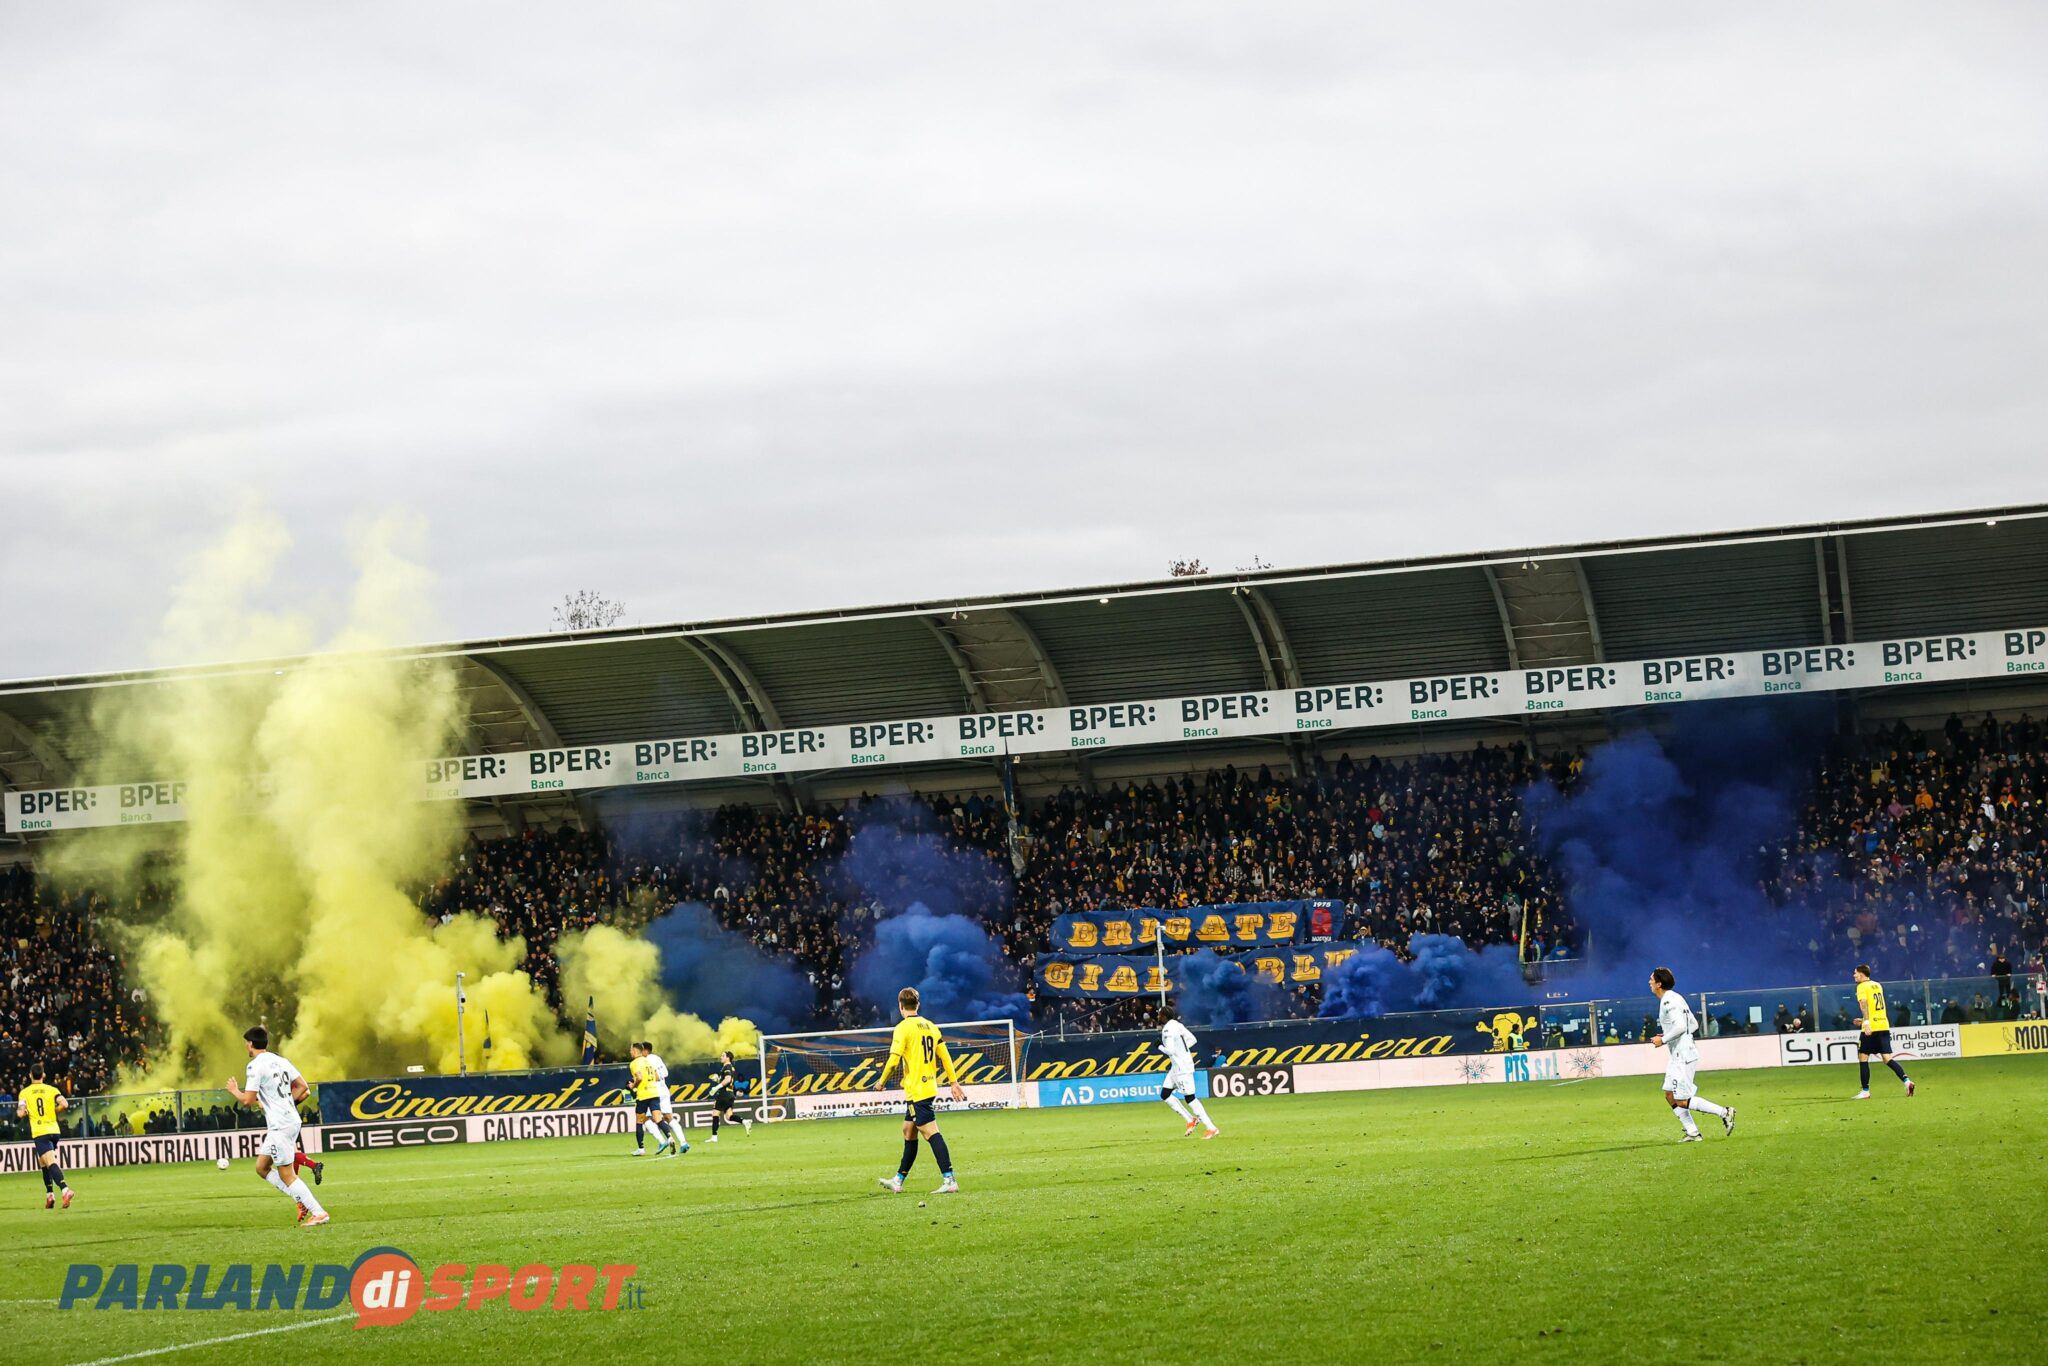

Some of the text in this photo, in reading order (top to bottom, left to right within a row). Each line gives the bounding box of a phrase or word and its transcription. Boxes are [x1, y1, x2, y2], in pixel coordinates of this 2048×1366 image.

[1762, 647, 1854, 676] BPER:
[1882, 637, 1976, 666] BPER:
[1643, 657, 1735, 685] BPER:
[1884, 670, 1922, 682] Banca
[2006, 660, 2045, 672] Banca
[1409, 676, 1499, 704] BPER:
[1526, 667, 1616, 694] BPER:
[1764, 680, 1801, 692] Banca
[1295, 685, 1383, 713] BPER:
[1527, 698, 1564, 710] Banca
[1645, 689, 1682, 701] Banca
[1070, 704, 1155, 731] BPER:
[1181, 695, 1268, 722] BPER:
[1411, 707, 1448, 720] Banca
[959, 713, 1044, 740] BPER:
[1183, 726, 1218, 738] Banca
[1296, 717, 1332, 729] Banca
[741, 730, 825, 757] BPER:
[850, 722, 934, 749] BPER:
[1071, 734, 1106, 746] Banca
[635, 739, 717, 766] BPER:
[851, 752, 885, 764] Banca
[960, 743, 994, 755] Banca
[425, 757, 506, 784] BPER:
[530, 748, 611, 775] BPER:
[743, 760, 777, 772] Banca
[531, 778, 564, 790] Banca
[636, 770, 670, 781] Banca
[20, 790, 96, 814] BPER:
[120, 782, 187, 808] BPER
[21, 819, 52, 830] Banca
[1068, 912, 1298, 947] BRIGATE
[1226, 1034, 1455, 1067] maniera
[1902, 1040, 1955, 1050] di guida
[1504, 1054, 1530, 1082] PTS
[1061, 1086, 1094, 1105] AD
[1212, 1070, 1290, 1098] 06:32
[36, 1098, 44, 1116] 8
[671, 1105, 787, 1128] IECO
[797, 1110, 836, 1119] GoldBet
[852, 1107, 892, 1117] GoldBet
[968, 1100, 1009, 1110] GoldBet
[329, 1125, 459, 1150] RIECO
[484, 1111, 628, 1142] CALCESTRUZZO
[95, 1137, 210, 1168] INDUSTRIALI
[215, 1136, 233, 1161] IN
